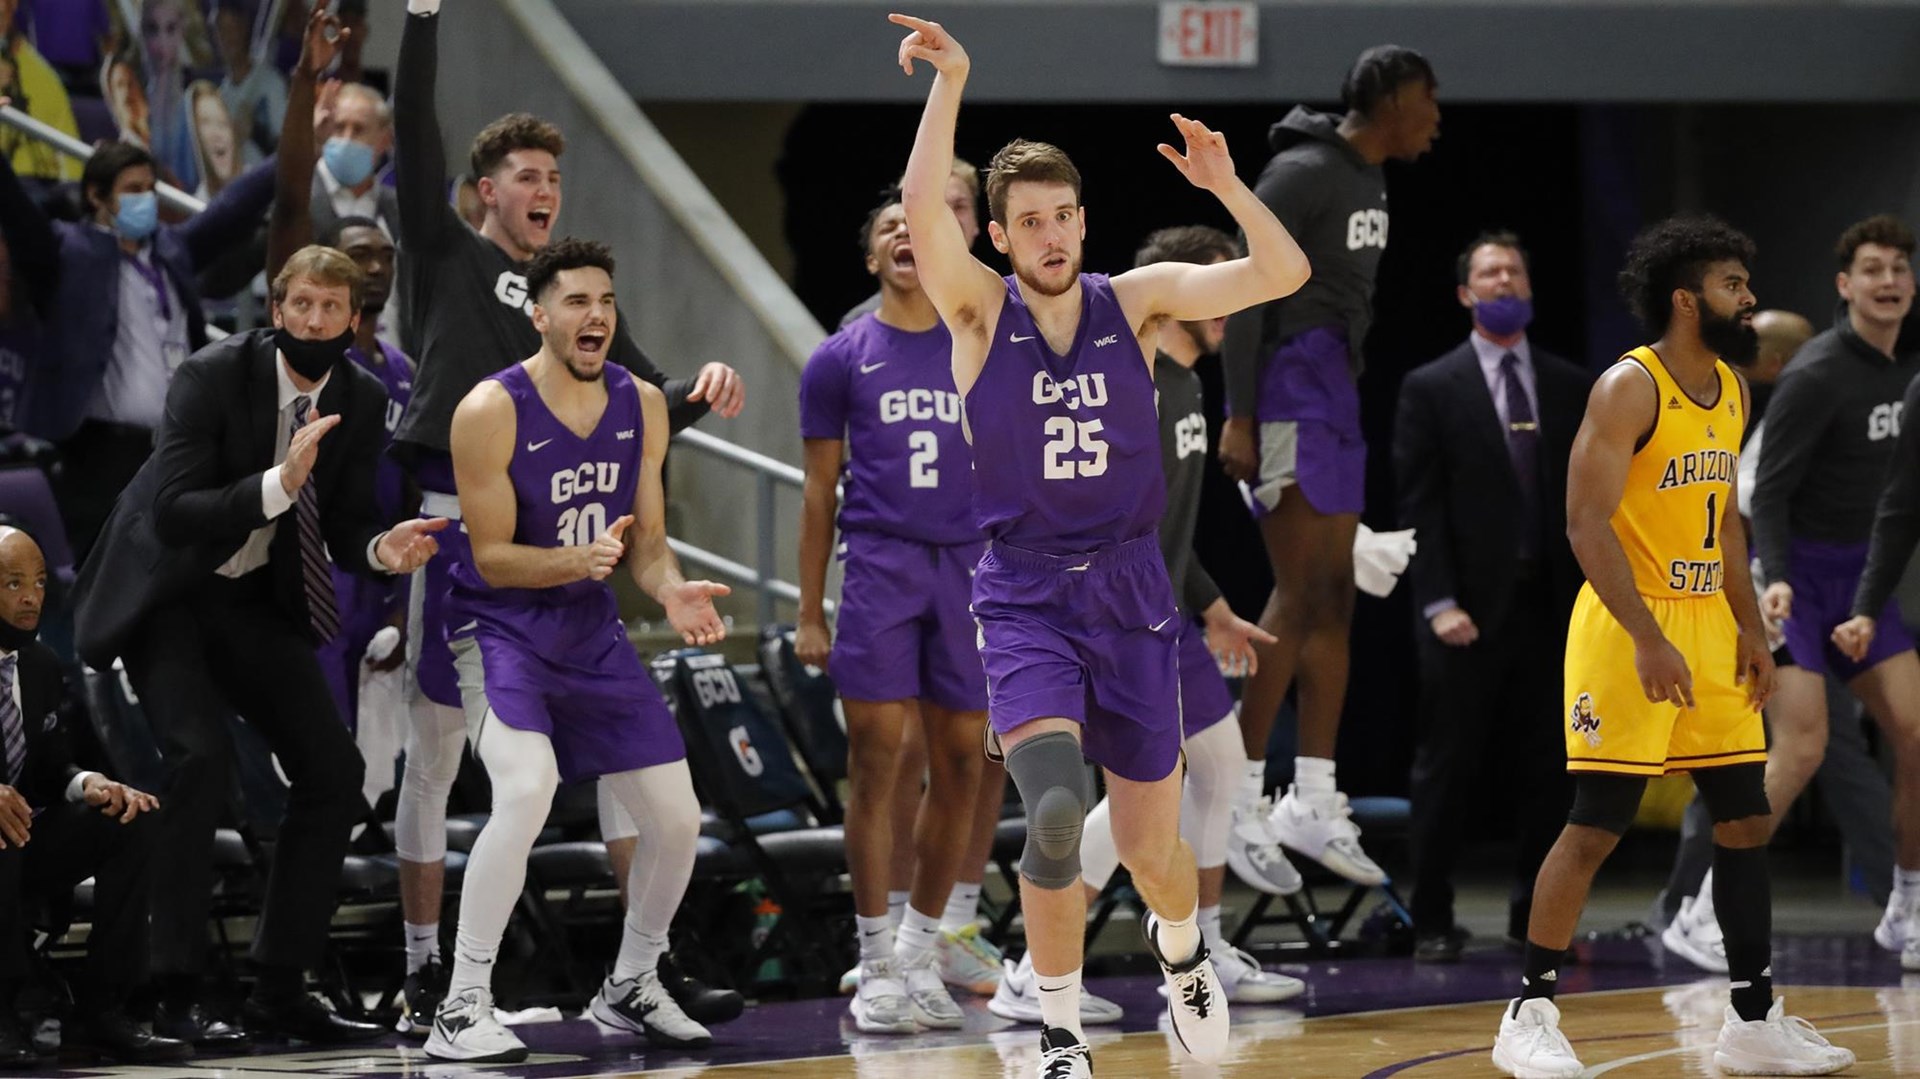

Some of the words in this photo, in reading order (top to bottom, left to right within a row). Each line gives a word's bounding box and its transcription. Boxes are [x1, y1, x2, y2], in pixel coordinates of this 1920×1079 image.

[1179, 7, 1241, 58] EXIT
[1094, 334, 1118, 348] WAC
[879, 388, 960, 425] GCU
[1032, 370, 1109, 410] GCU
[908, 430, 939, 488] 2
[1043, 416, 1110, 480] 25
[551, 461, 621, 504] GCU
[556, 502, 607, 547] 30
[1703, 492, 1717, 550] 1
[692, 667, 742, 708] GCU
